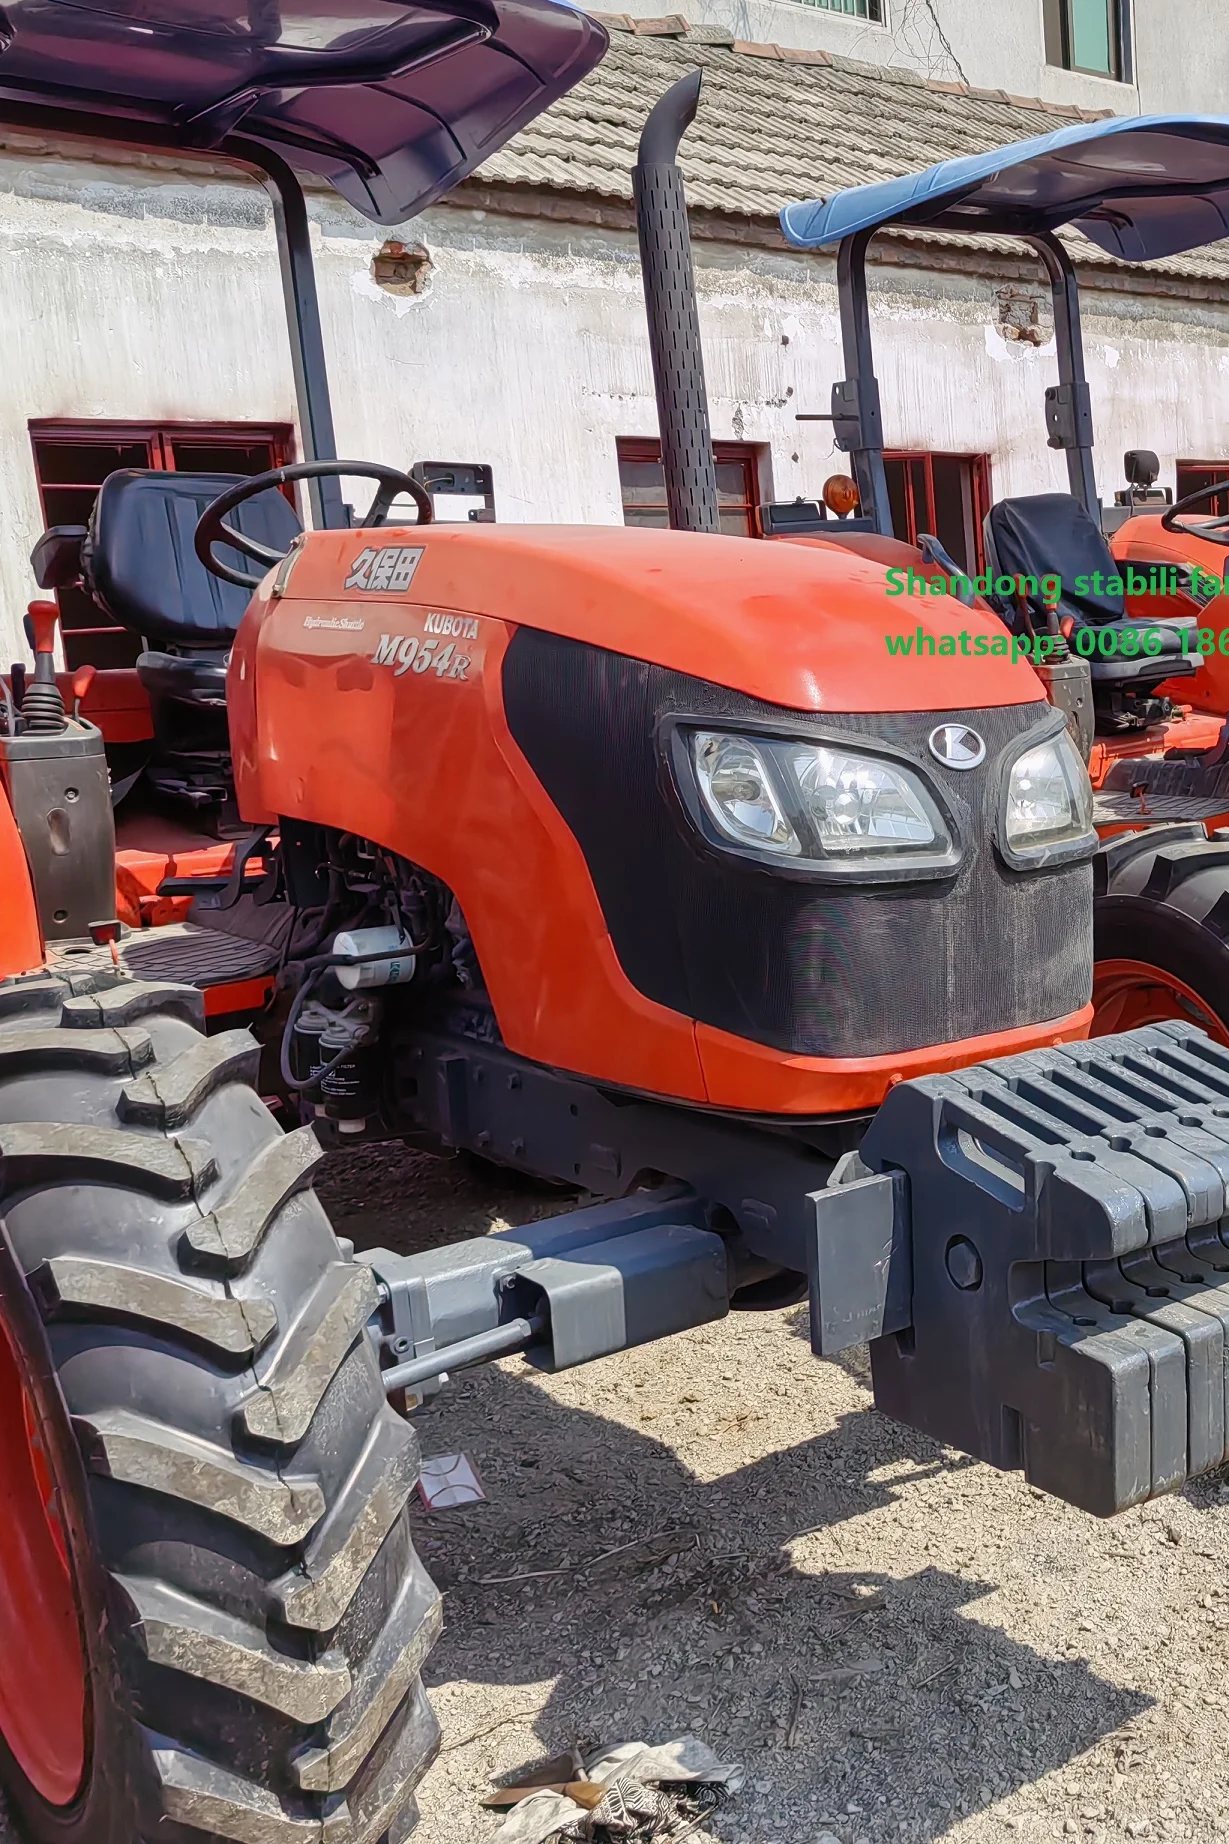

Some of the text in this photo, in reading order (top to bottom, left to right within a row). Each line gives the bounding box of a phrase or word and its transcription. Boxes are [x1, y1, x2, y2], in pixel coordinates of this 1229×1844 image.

[344, 546, 426, 591] 久保田
[423, 612, 479, 639] KUBOTA
[370, 634, 471, 680] M954R
